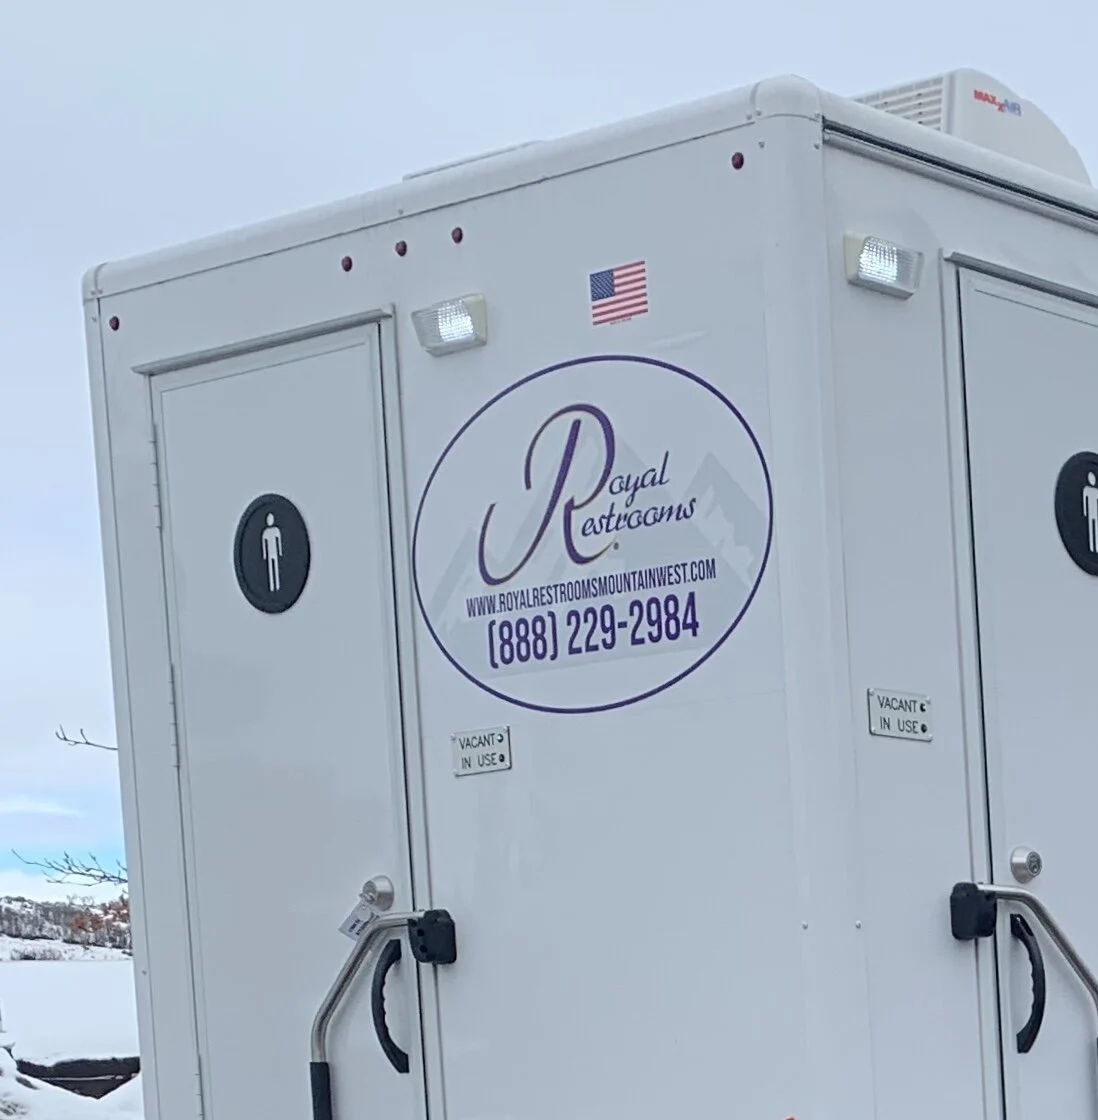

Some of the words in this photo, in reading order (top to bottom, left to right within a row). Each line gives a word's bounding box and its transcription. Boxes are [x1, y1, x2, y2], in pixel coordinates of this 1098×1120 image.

[466, 558, 717, 617] WWW.ROYALRESTROOMSMOUNTAINWEST.COM
[567, 591, 699, 655] 229-2984
[877, 695, 918, 713] VACANT
[880, 716, 890, 730] IN
[898, 718, 919, 734] USE
[459, 733, 495, 750] VACANT
[461, 756, 471, 769] IN
[478, 753, 497, 767] USE
